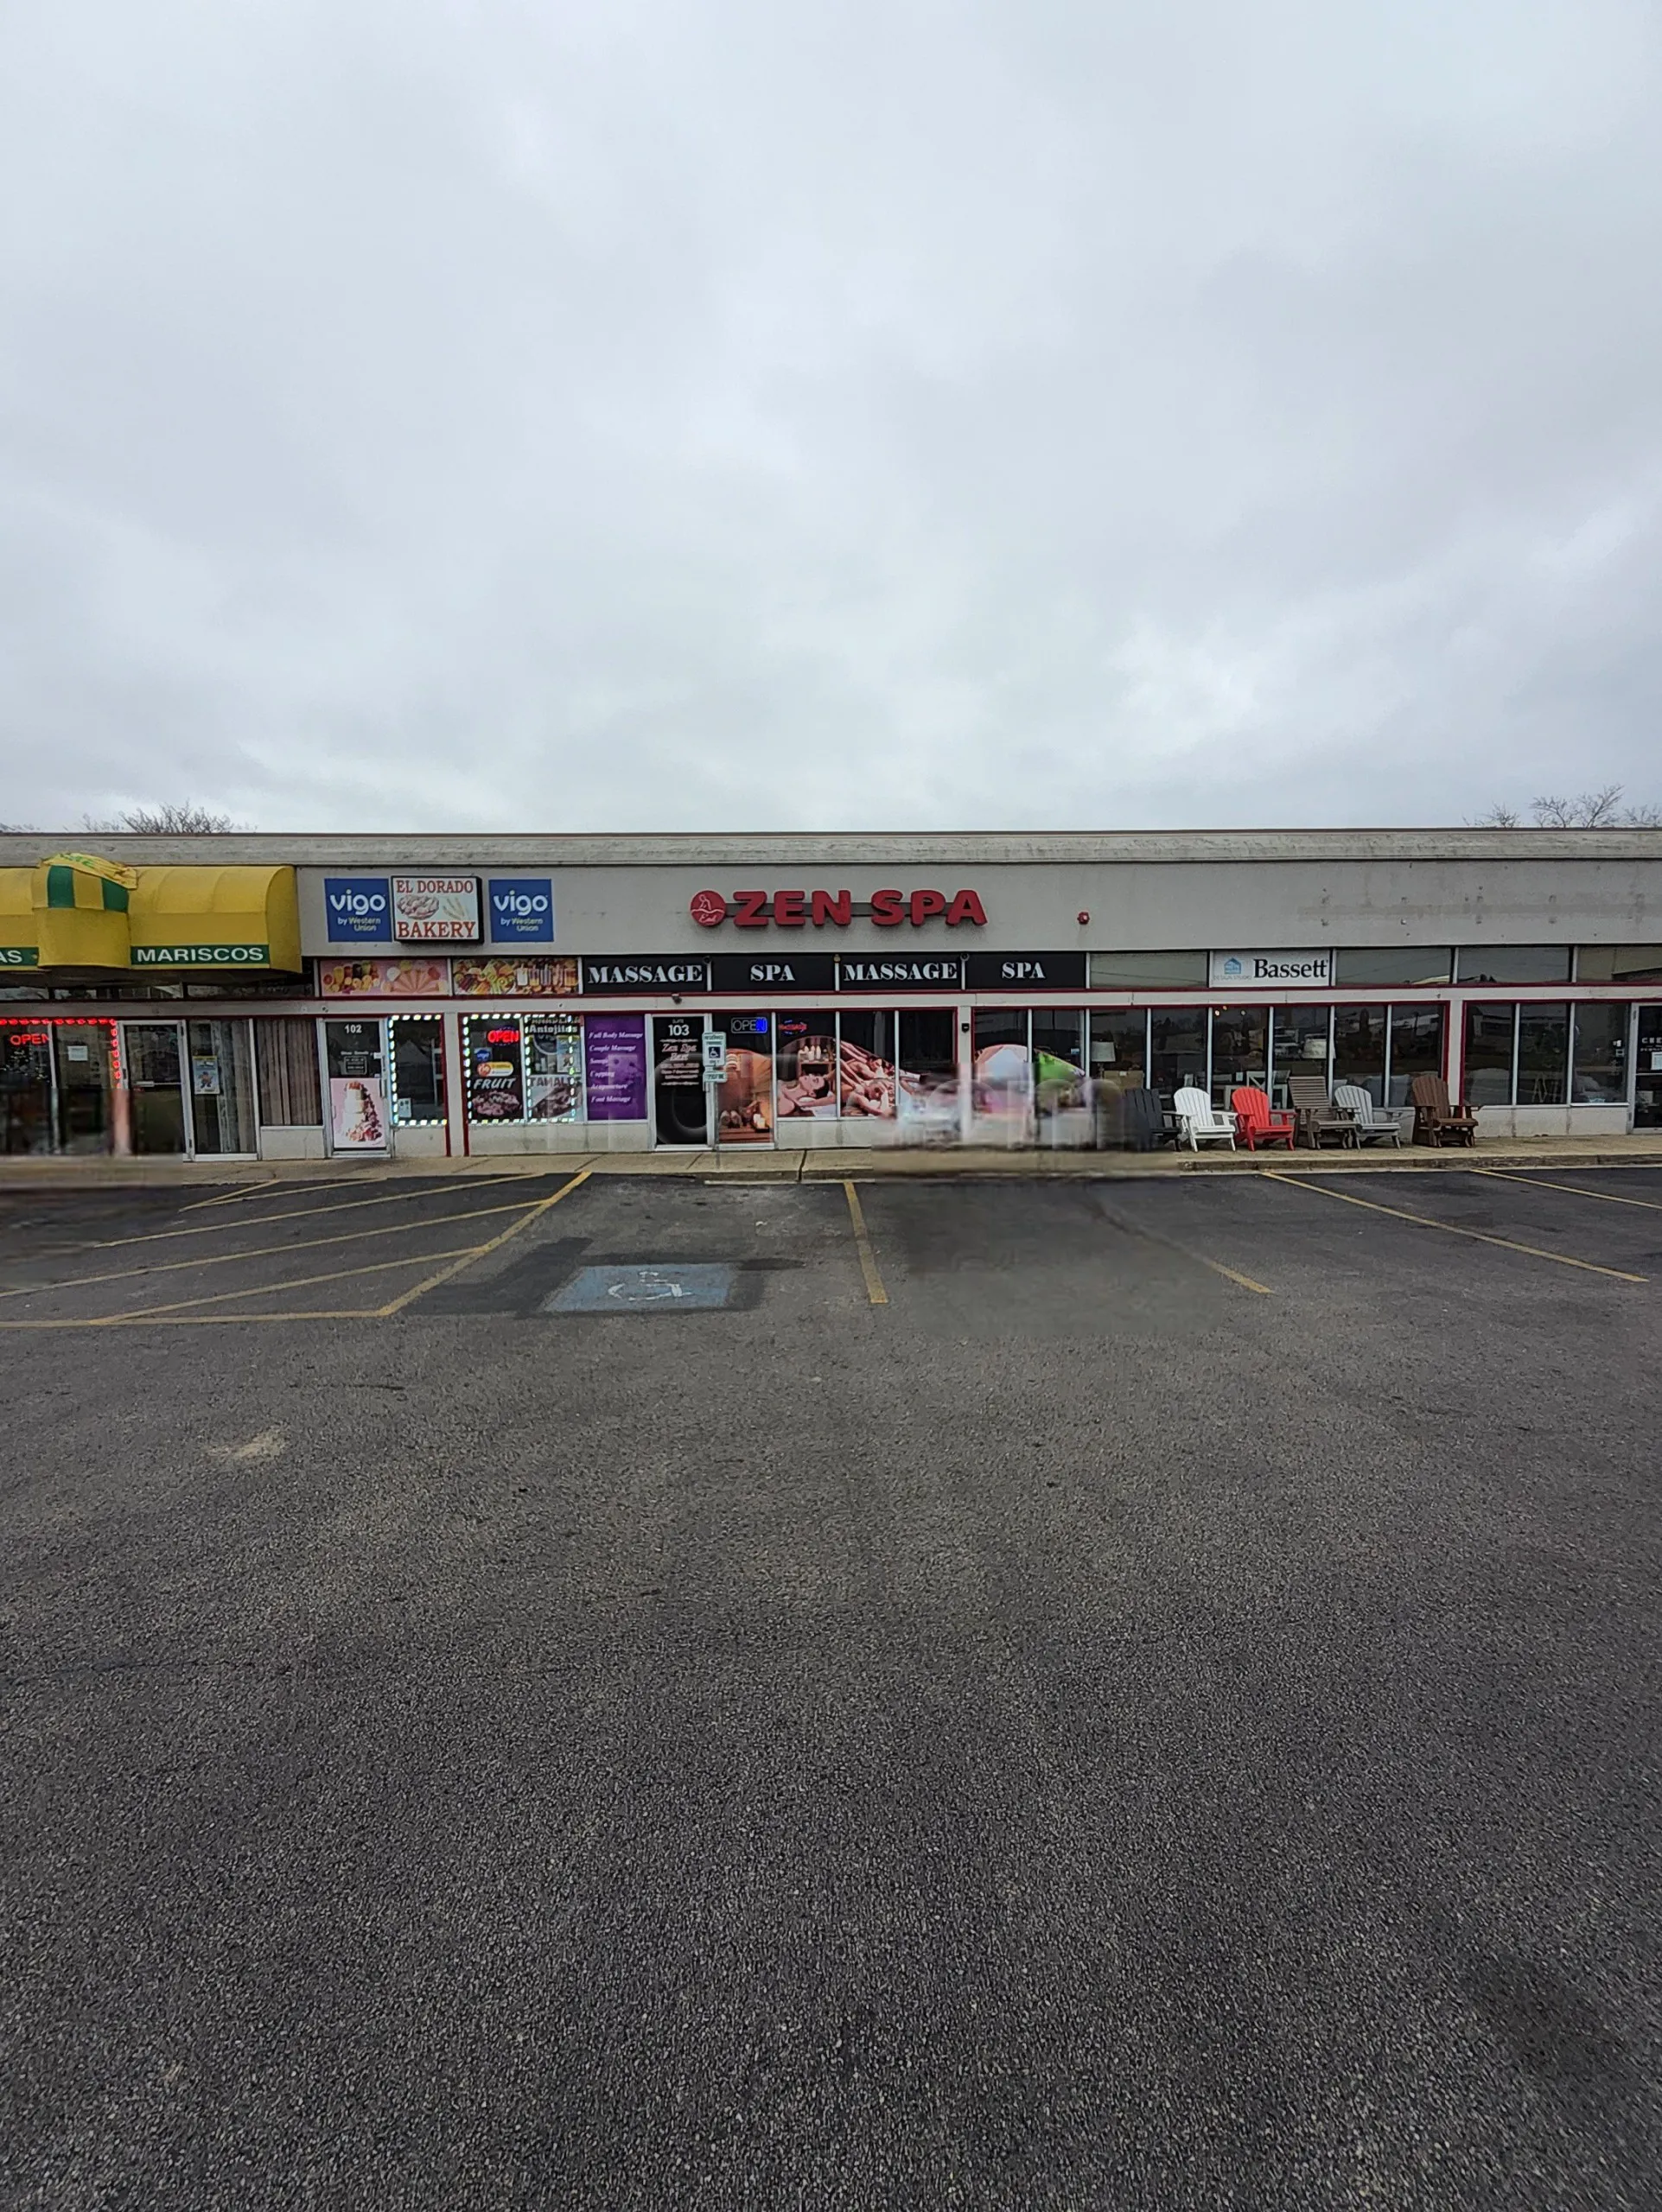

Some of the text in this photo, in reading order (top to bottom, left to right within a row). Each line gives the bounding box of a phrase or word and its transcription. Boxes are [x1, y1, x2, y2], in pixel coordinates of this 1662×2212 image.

[396, 880, 474, 893] EL DORADO
[329, 889, 386, 916] vigo
[493, 889, 549, 916] vigo
[732, 889, 988, 928] ZEN SPA
[338, 917, 381, 925] by Western
[500, 918, 511, 926] by
[398, 921, 476, 938] BAKERY
[137, 947, 264, 963] MARISCOS
[588, 964, 703, 983] MASSAGE
[750, 964, 795, 982] SPA
[844, 963, 958, 982] MASSAGE
[1002, 962, 1046, 979] SPA
[1253, 958, 1328, 978] Bassett
[344, 1024, 362, 1033] 102
[668, 1024, 690, 1036] 103
[733, 1019, 766, 1031] OPEN
[10, 1033, 49, 1046] OPEN
[487, 1030, 519, 1043] OPEN
[661, 1043, 697, 1053] Zen Spa
[473, 1077, 516, 1090] FRUIT
[528, 1077, 582, 1087] TAMAL
